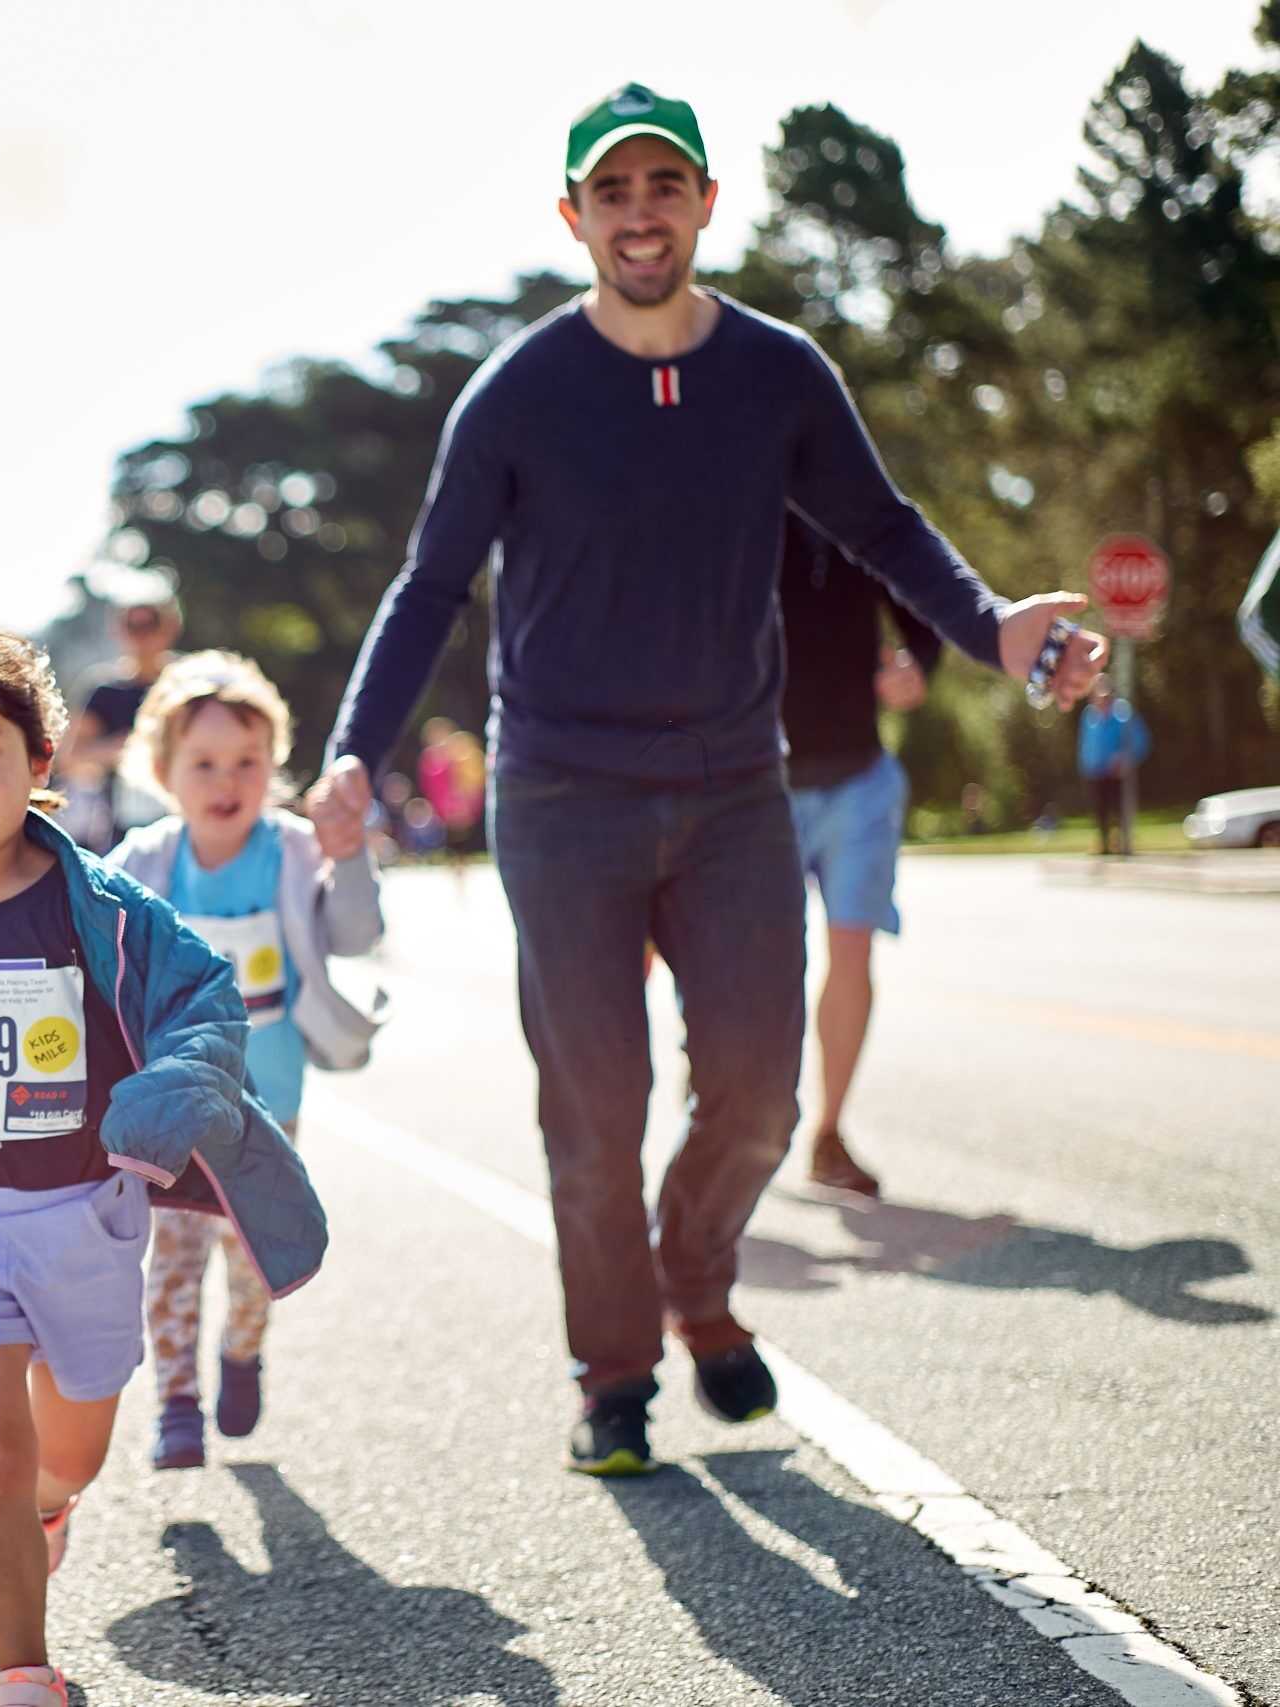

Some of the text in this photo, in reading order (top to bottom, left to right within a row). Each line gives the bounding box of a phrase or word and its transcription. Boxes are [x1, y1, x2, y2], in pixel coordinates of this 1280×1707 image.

[1094, 554, 1166, 600] STOP
[28, 1029, 61, 1050] KIDS
[33, 1041, 68, 1064] MILE
[33, 1090, 58, 1099] ROAD
